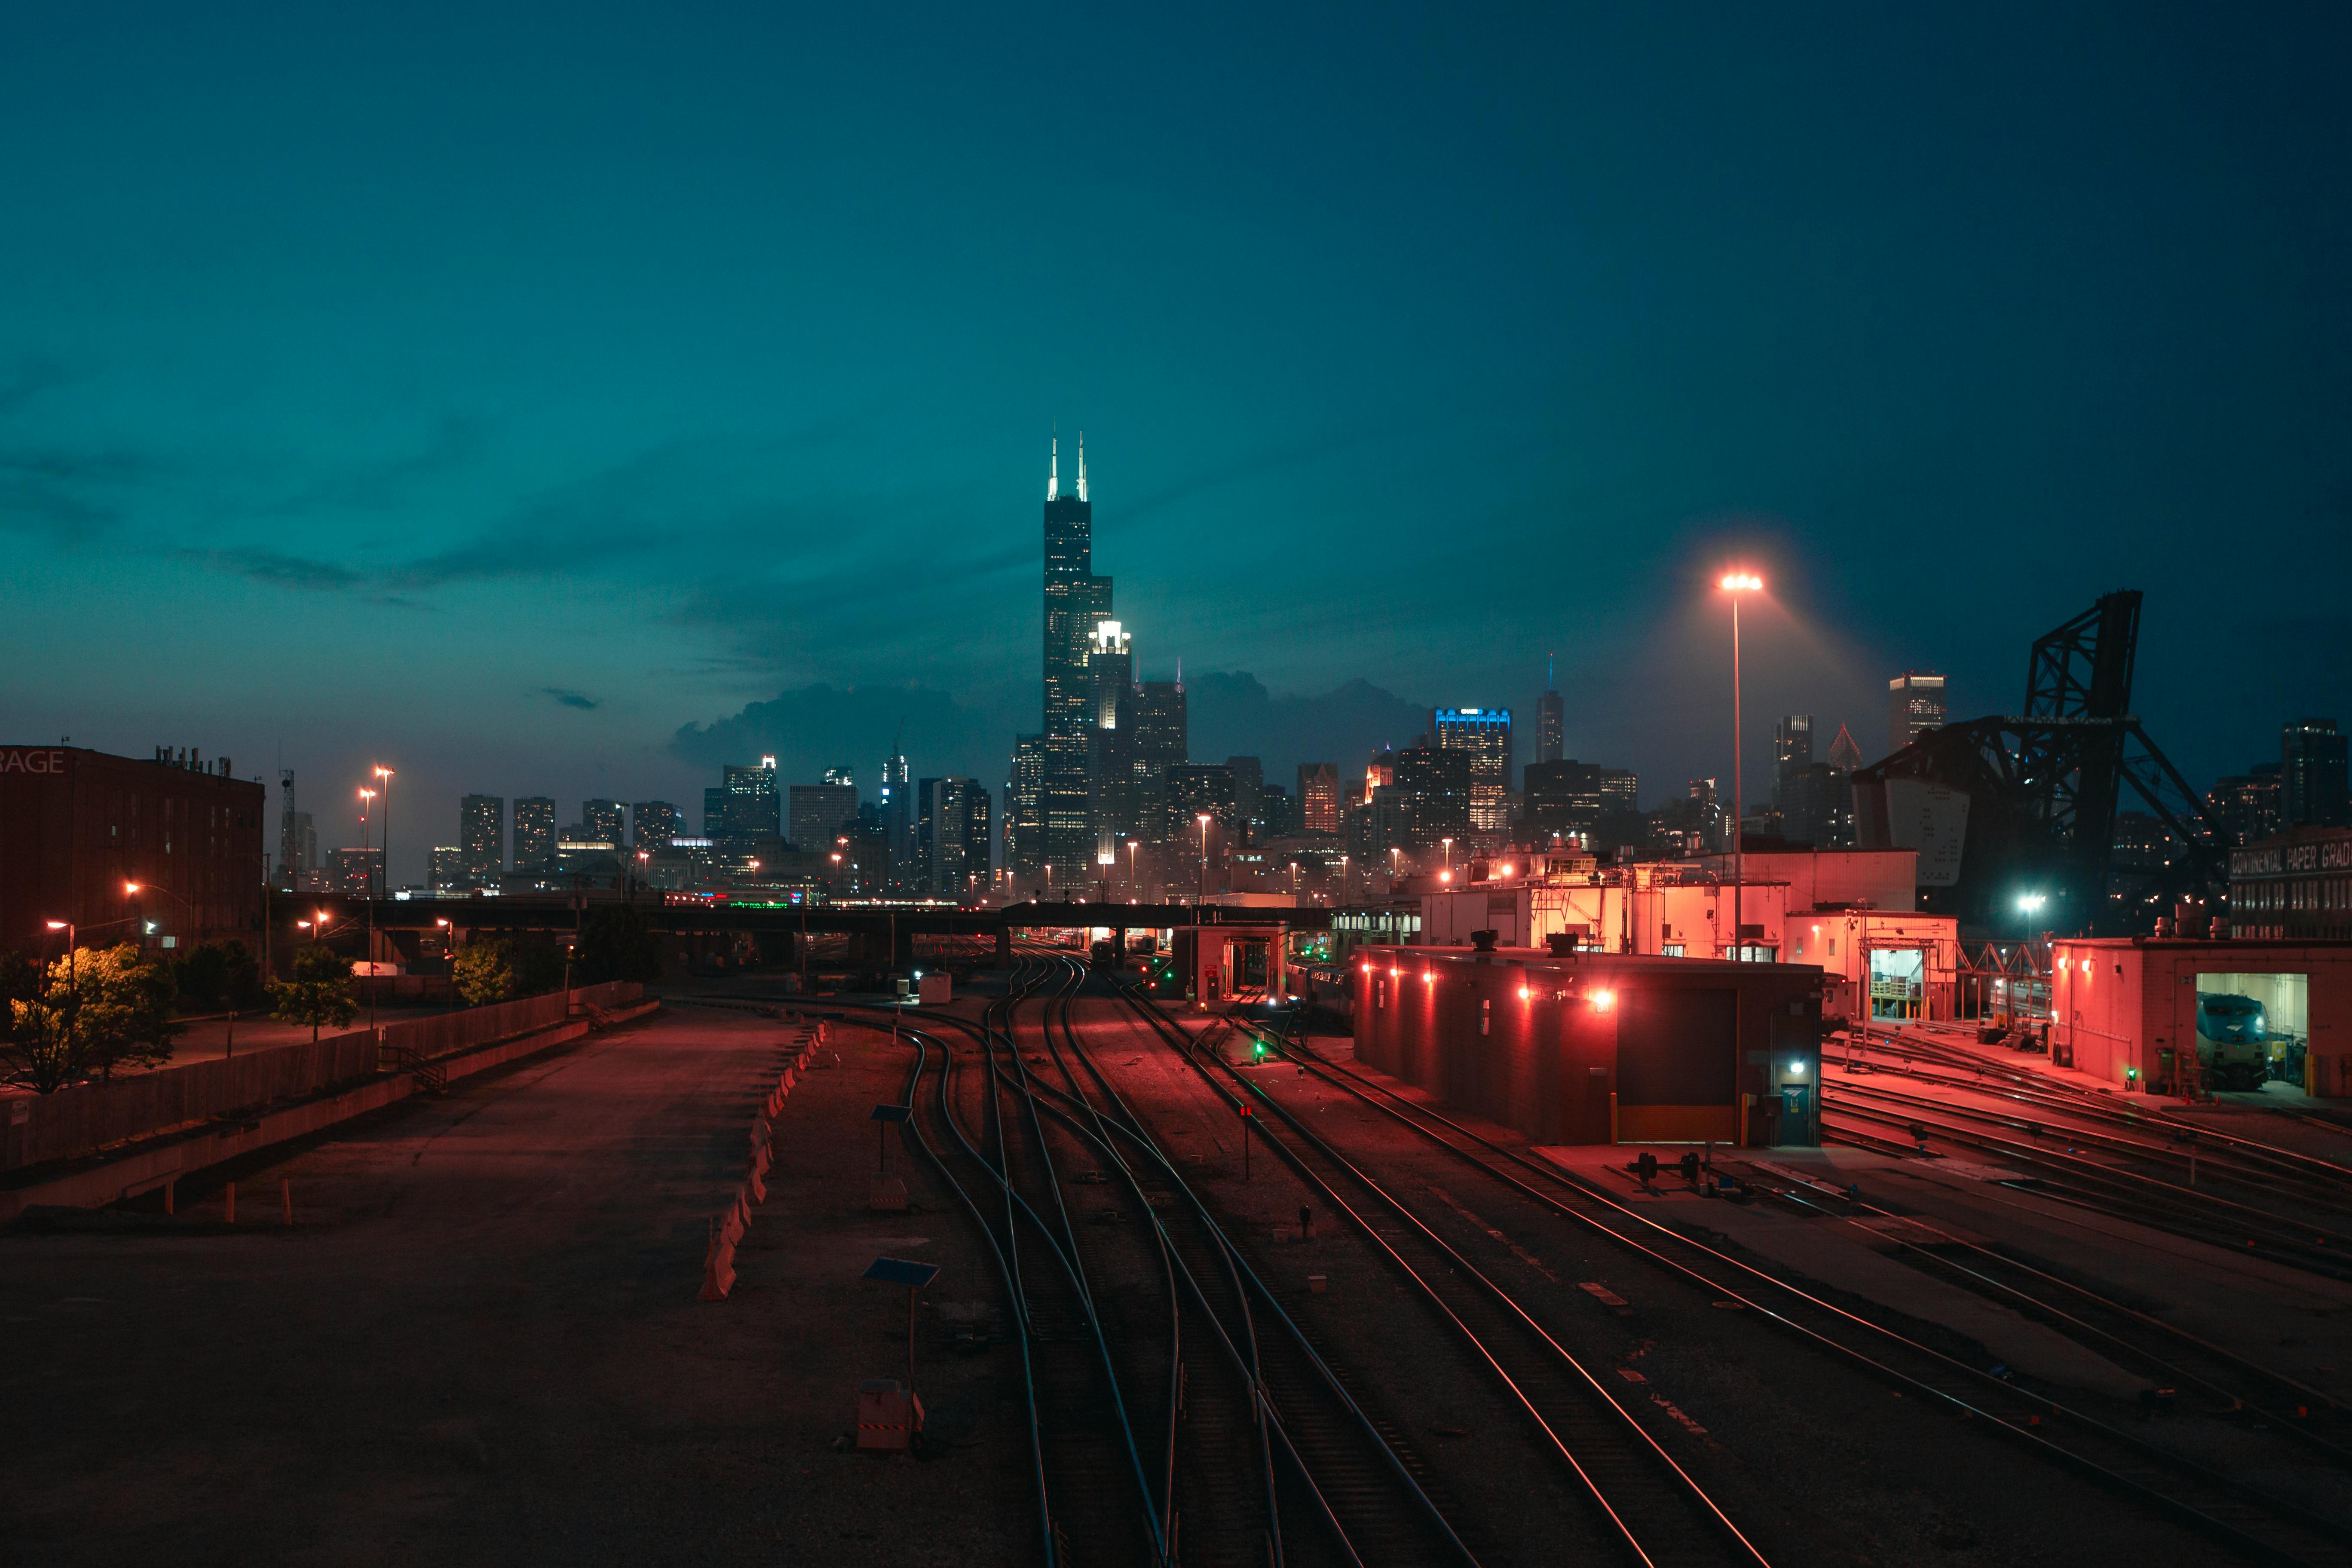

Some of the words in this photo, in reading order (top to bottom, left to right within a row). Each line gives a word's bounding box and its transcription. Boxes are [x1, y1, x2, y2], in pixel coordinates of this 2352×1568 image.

[2233, 850, 2282, 873] CONTINENTAL
[2287, 846, 2316, 870] PAPER
[2322, 842, 2352, 867] GRAD
